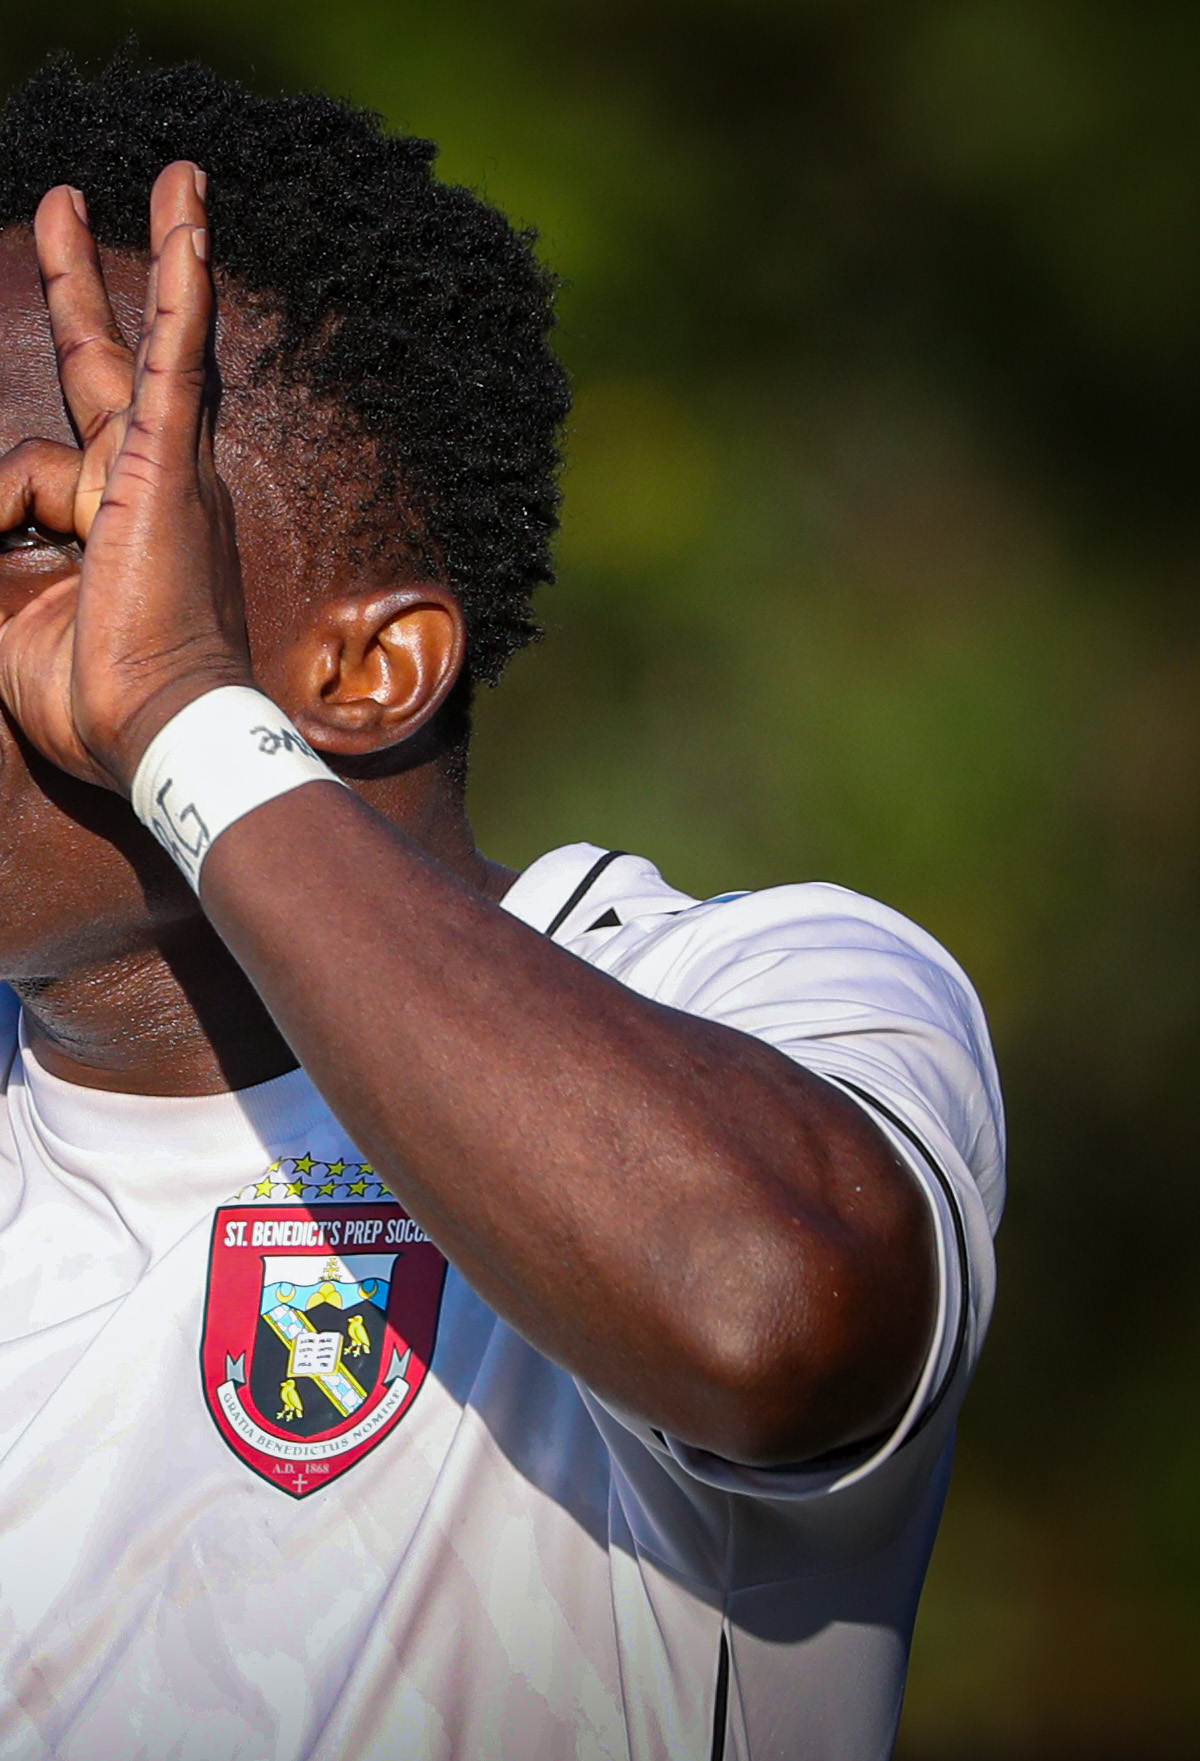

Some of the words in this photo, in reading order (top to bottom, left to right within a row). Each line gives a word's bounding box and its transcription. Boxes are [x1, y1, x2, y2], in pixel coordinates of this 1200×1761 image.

[224, 1221, 248, 1247] ST.
[252, 1219, 341, 1247] BENEDICT'S
[343, 1219, 383, 1245] PREP
[223, 1392, 255, 1439] GRATIA
[256, 1435, 349, 1456] BENEDICTUS
[353, 1389, 403, 1441] NOMINE
[305, 1463, 330, 1475] 1868
